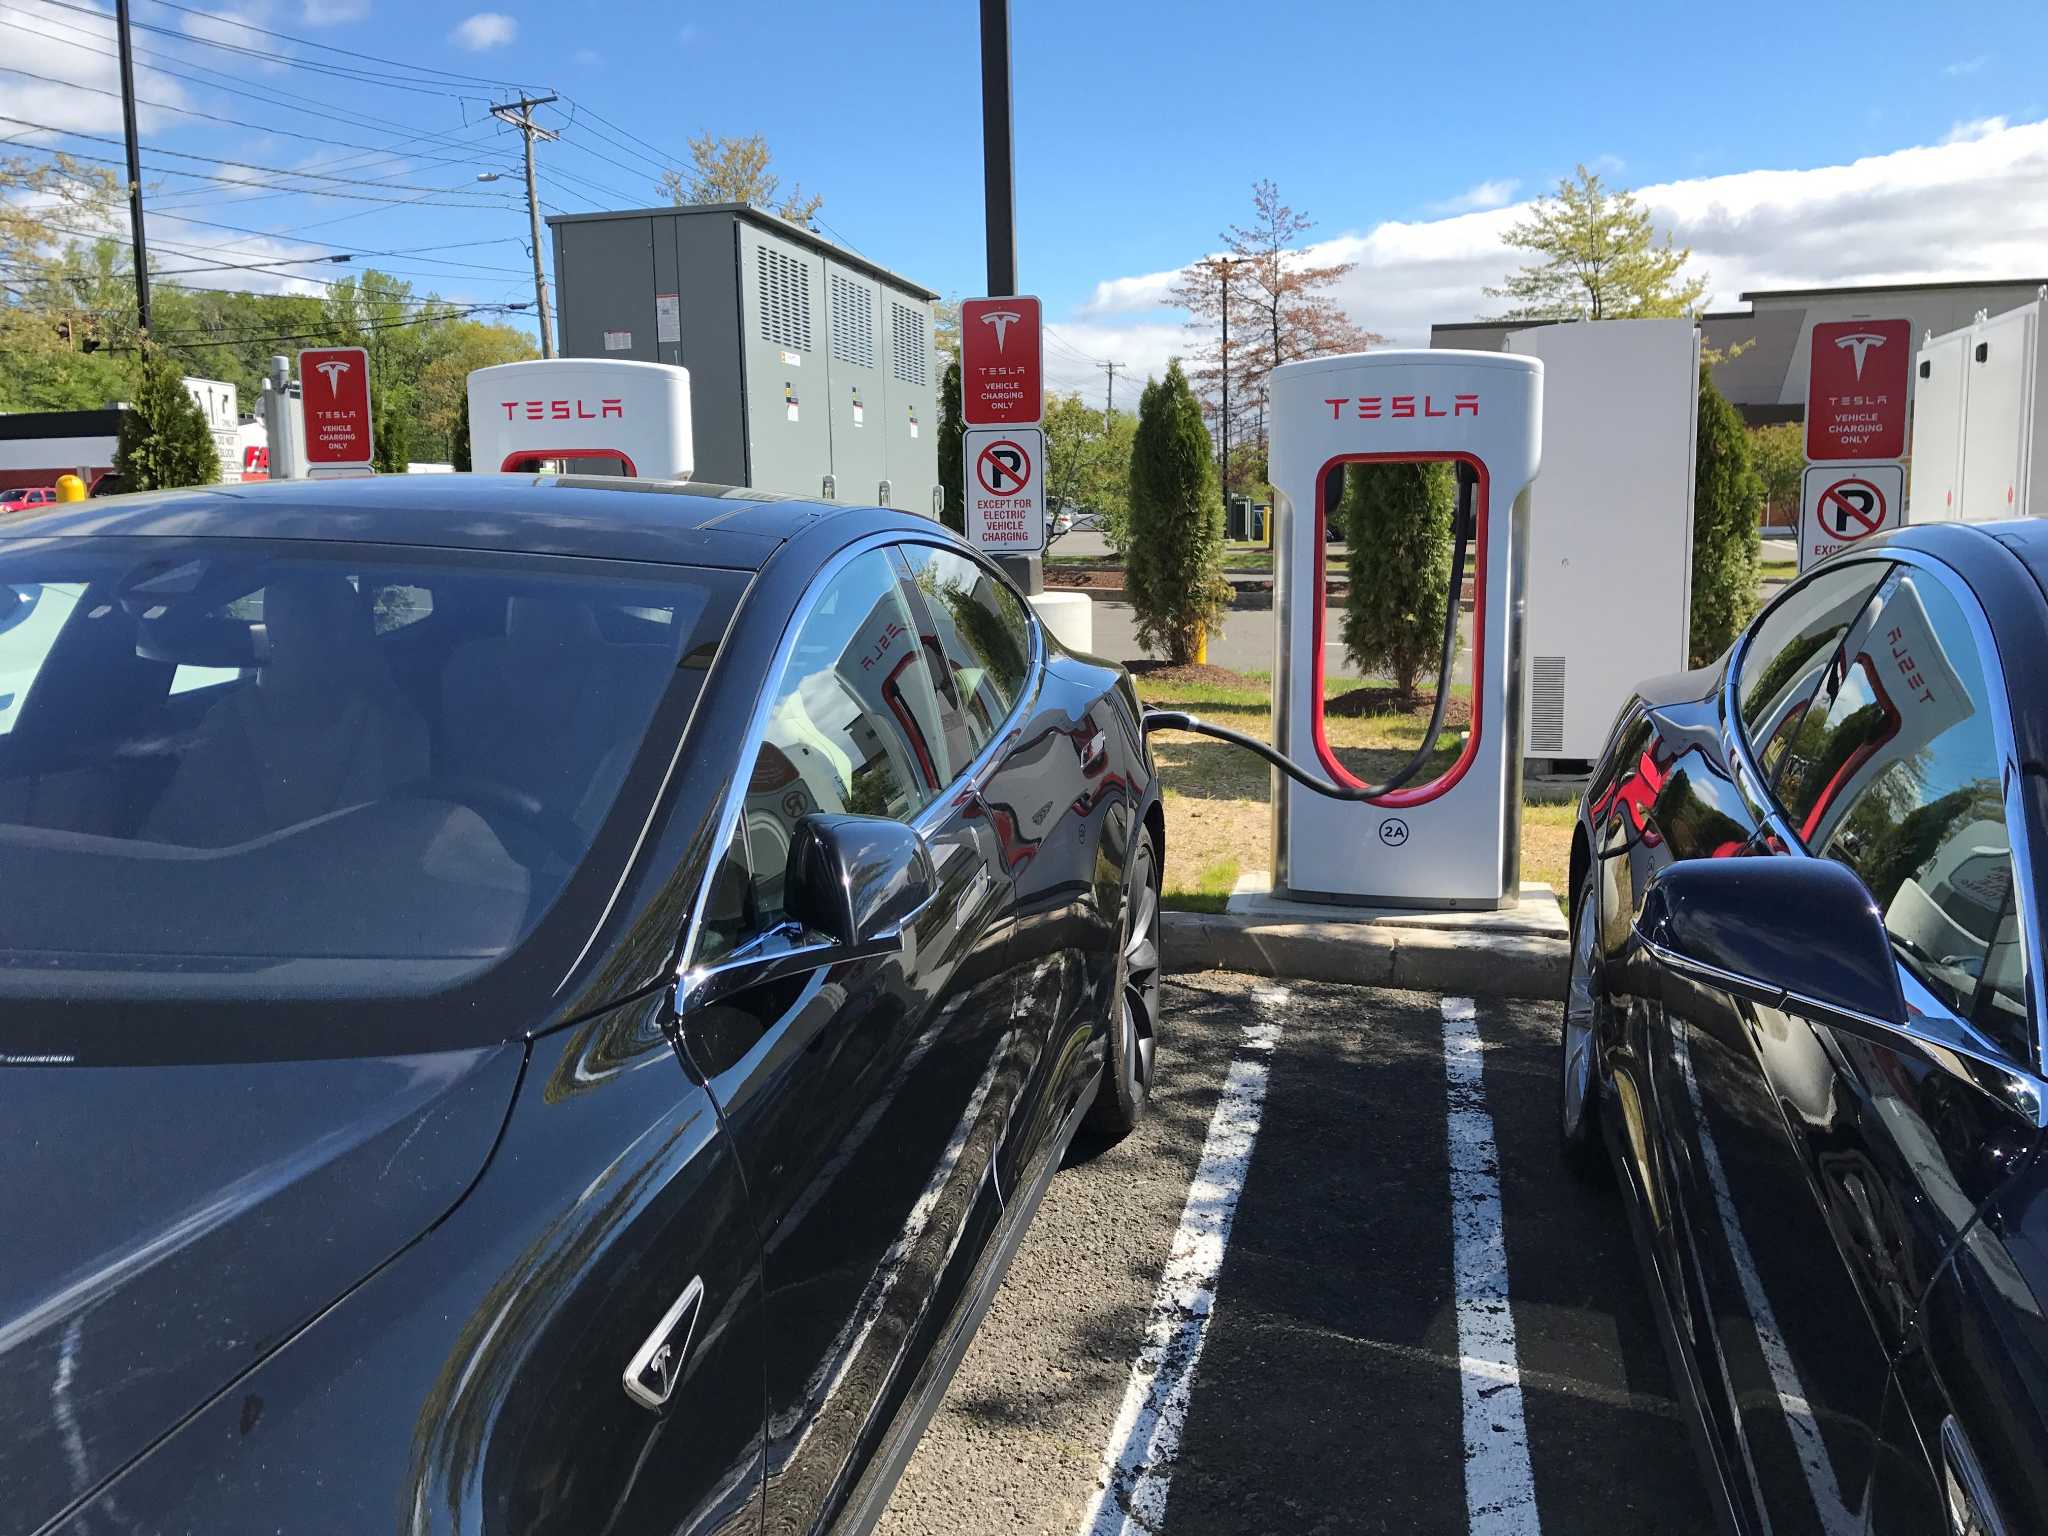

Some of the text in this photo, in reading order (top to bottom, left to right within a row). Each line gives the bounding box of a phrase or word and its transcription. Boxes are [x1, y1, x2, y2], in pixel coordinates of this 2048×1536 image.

[979, 366, 1025, 376] TESLA
[984, 382, 1019, 390] VEHICLE
[980, 391, 1024, 400] CHARGING
[1828, 395, 1888, 406] TESLA
[501, 399, 624, 421] TESLA
[991, 402, 1014, 410] ONLY
[1324, 394, 1480, 420] TESLA
[316, 410, 356, 419] TESLA
[1834, 413, 1879, 422] VEHICLE
[322, 424, 352, 432] VEHICLE
[1828, 423, 1884, 433] CHARGING
[319, 433, 356, 441] CHARGING
[1840, 435, 1870, 444] ONLY
[328, 442, 348, 450] ONLY
[992, 450, 1021, 489] P
[977, 499, 1032, 509] EXCEPT FOR
[983, 510, 1026, 520] ELECTRIC
[1836, 489, 1875, 532] P
[986, 521, 1024, 531] VEHICLE
[982, 532, 1028, 542] CHARGING
[1383, 826, 1405, 838] 2A
